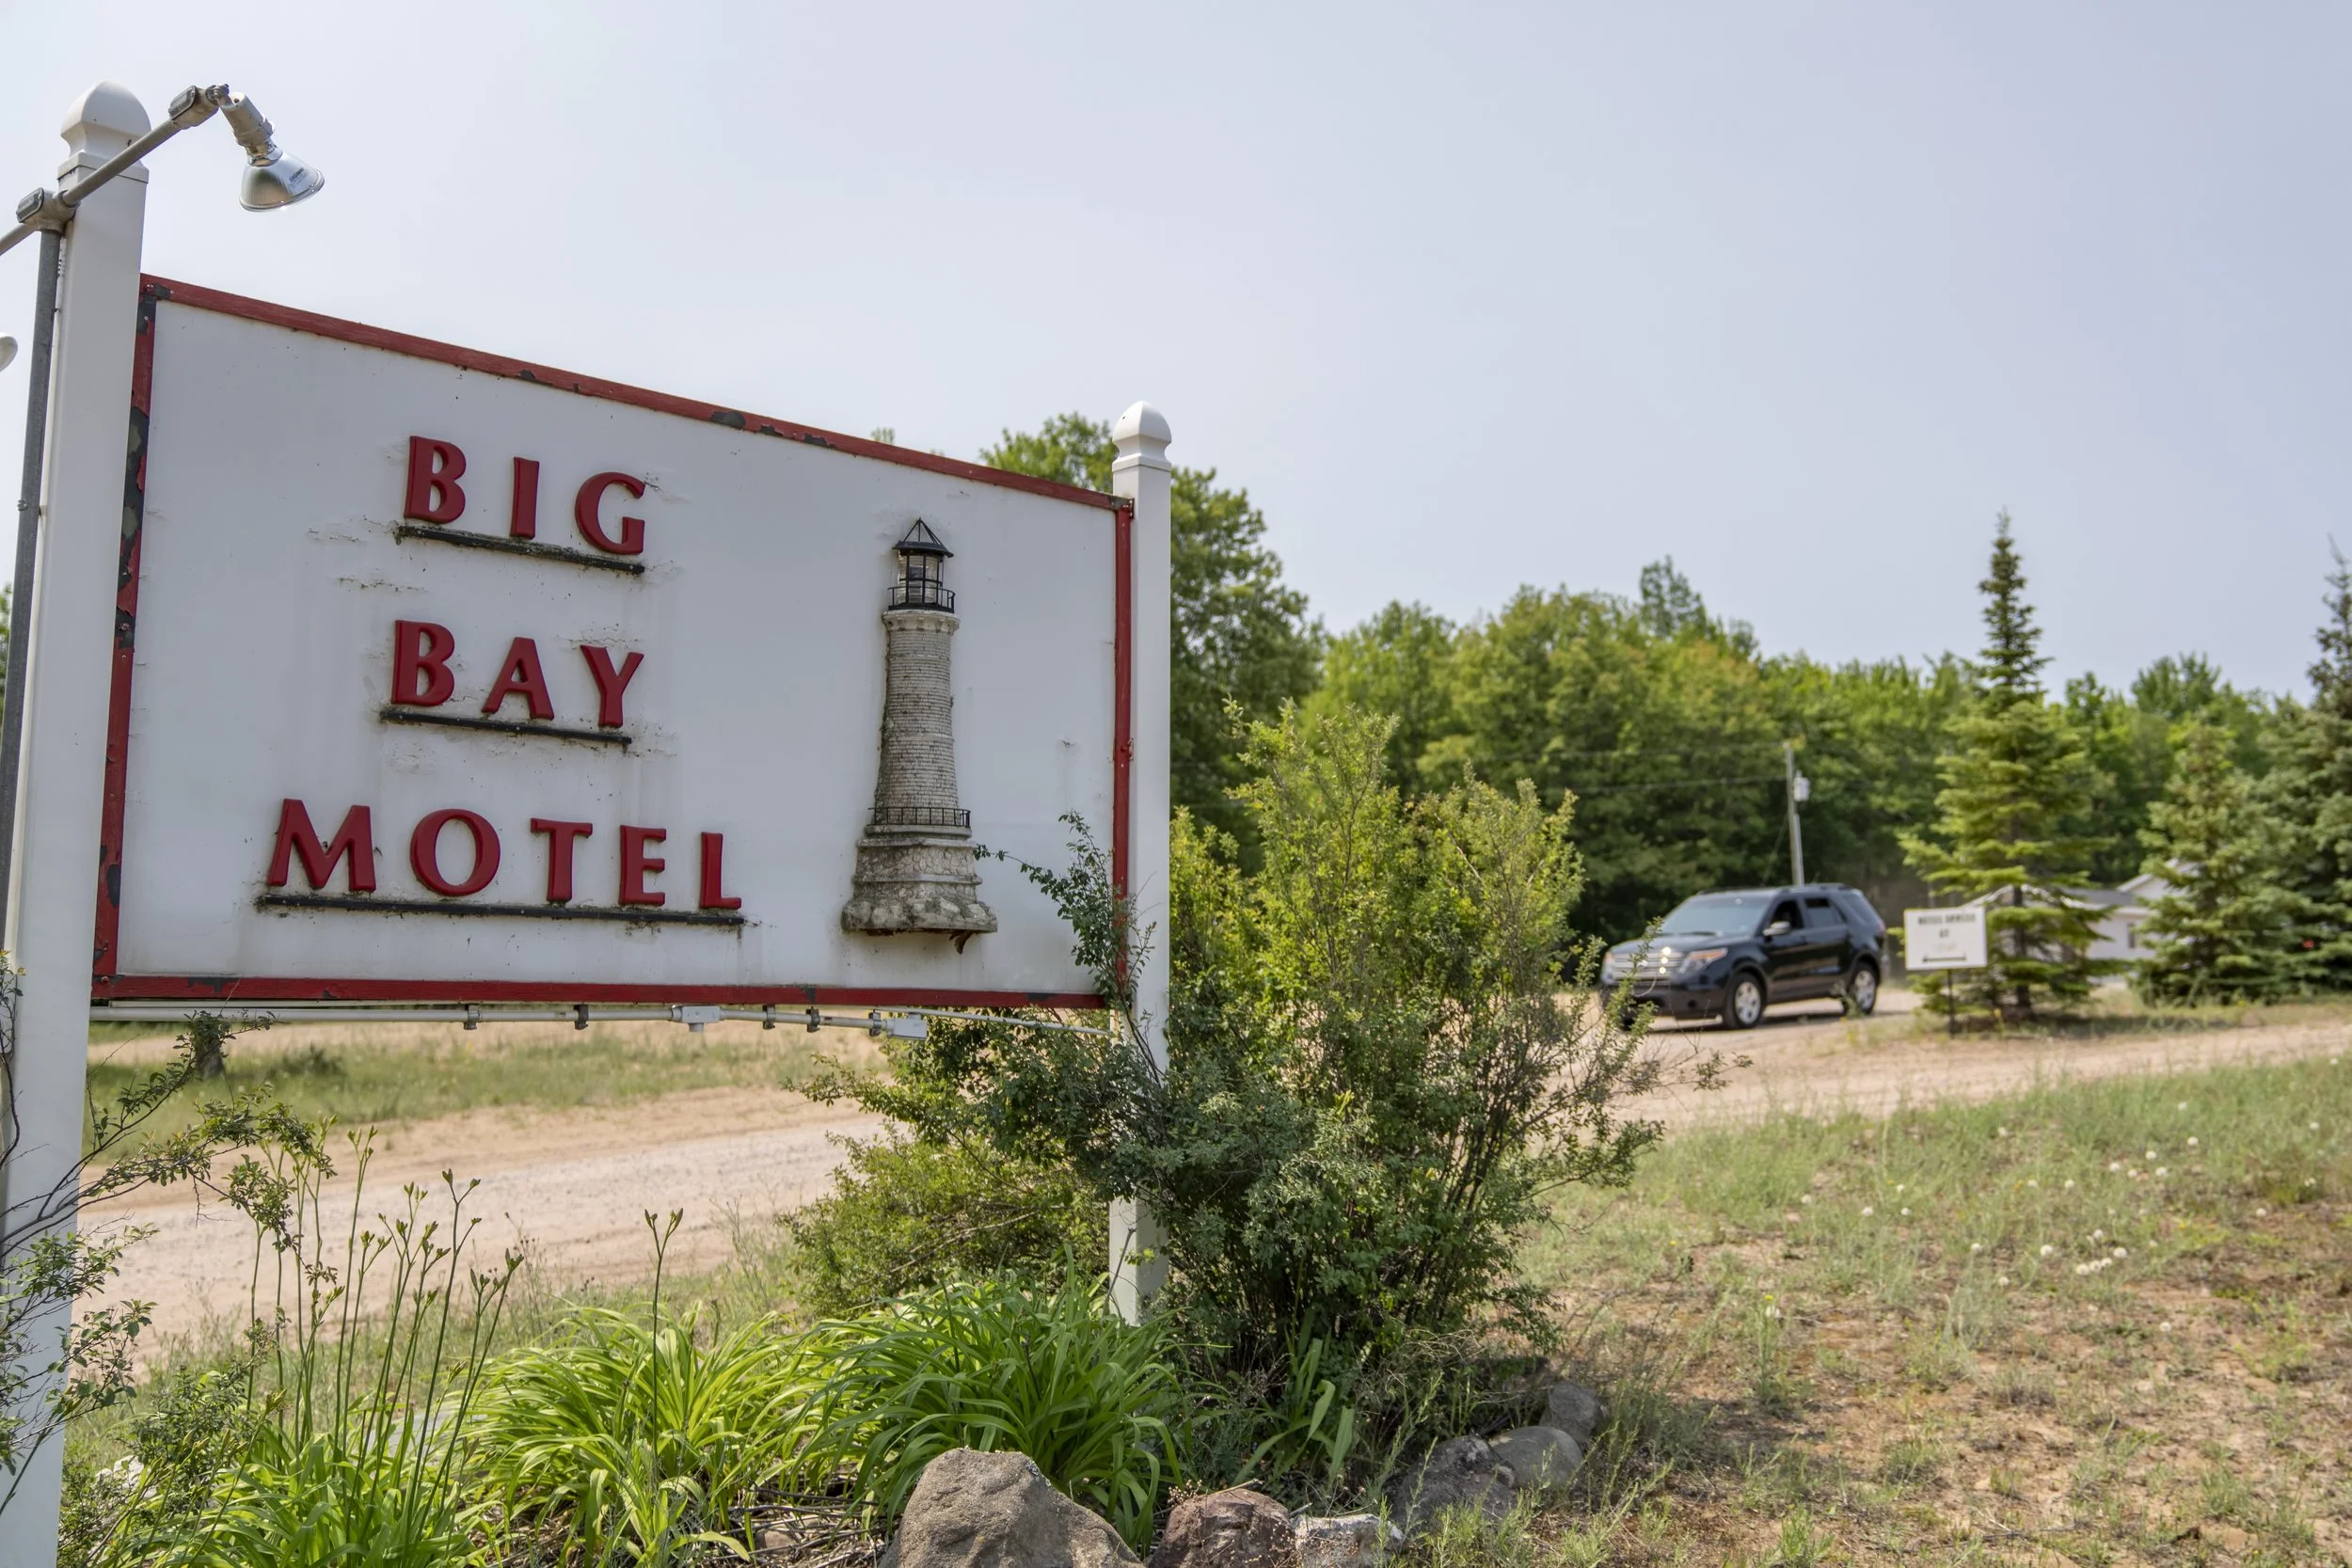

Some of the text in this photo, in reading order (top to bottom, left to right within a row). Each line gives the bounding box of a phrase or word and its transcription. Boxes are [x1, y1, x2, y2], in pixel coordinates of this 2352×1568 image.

[405, 436, 646, 555] BIG
[392, 620, 644, 728] BAY
[269, 799, 741, 909] MOTEL
